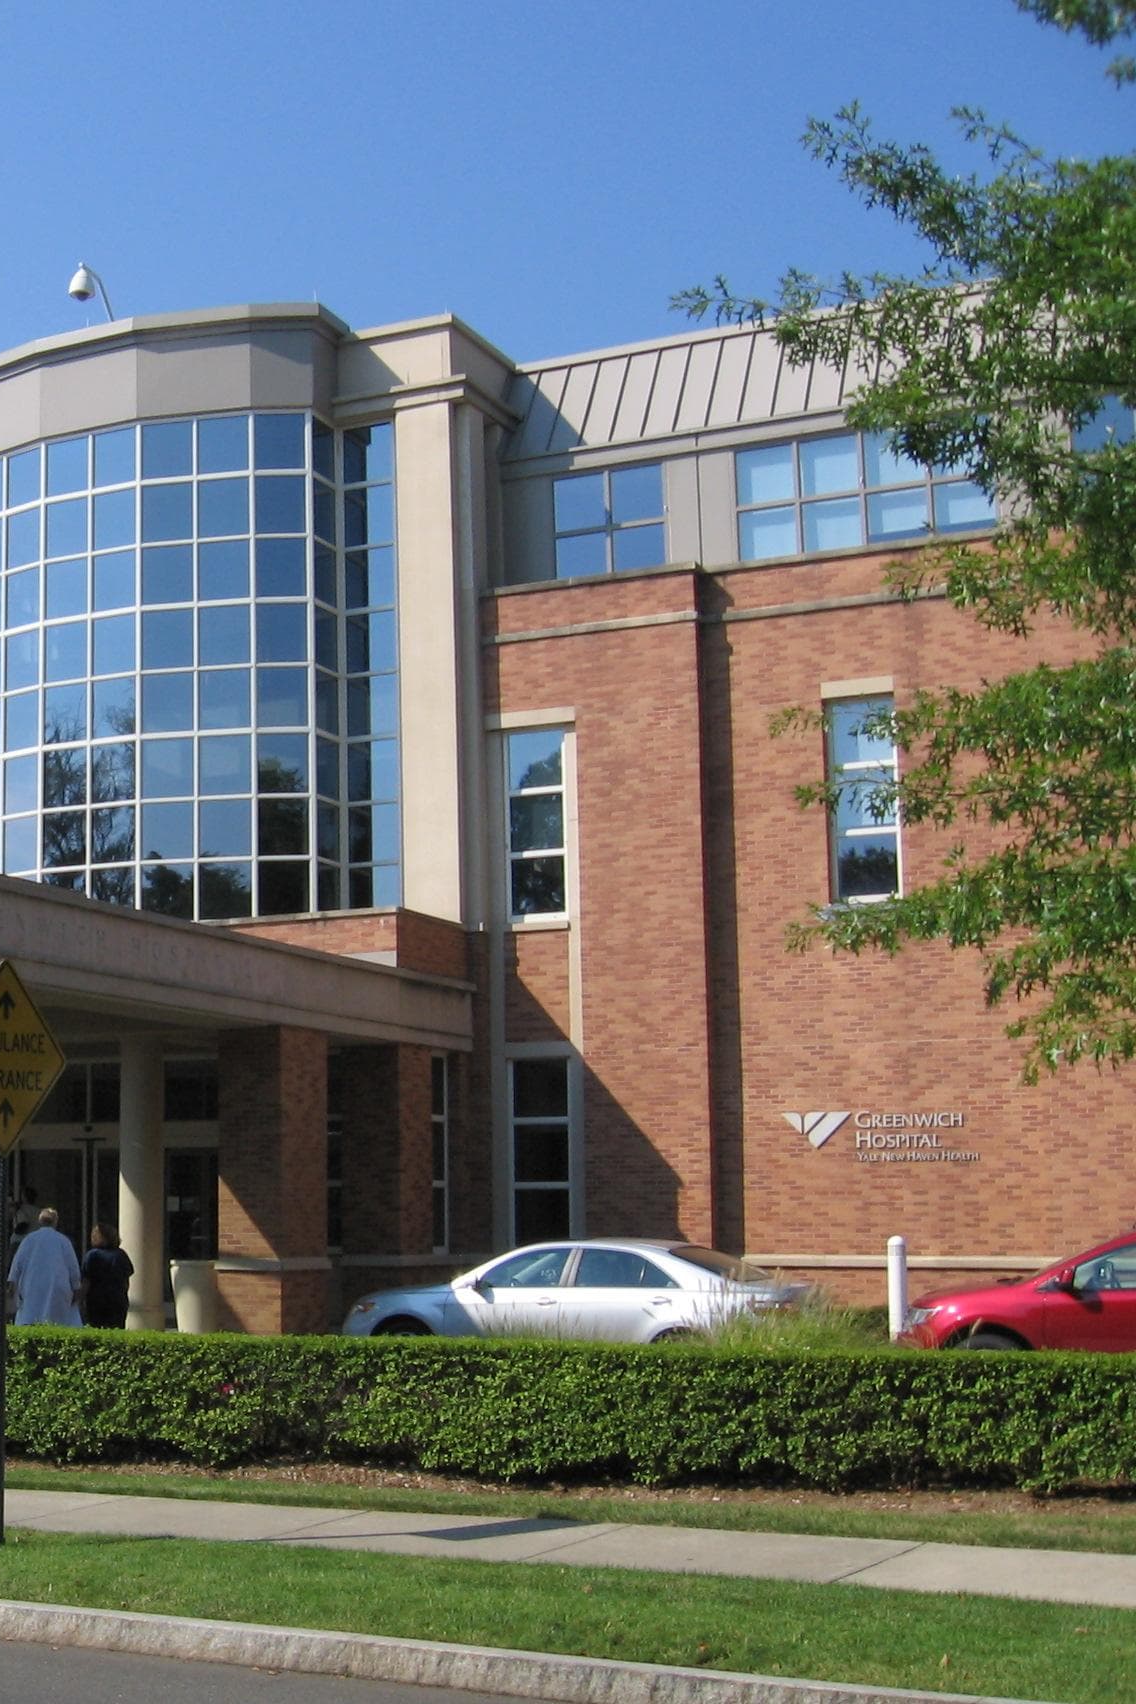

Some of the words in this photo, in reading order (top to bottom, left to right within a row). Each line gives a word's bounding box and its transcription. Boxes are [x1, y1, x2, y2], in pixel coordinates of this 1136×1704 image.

[854, 1110, 964, 1128] GREENWICH
[855, 1131, 942, 1149] HOSPITAL
[857, 1152, 878, 1162] YALE
[882, 1151, 905, 1162] NEW
[907, 1151, 939, 1162] HAVEN
[941, 1151, 980, 1162] HEALTH
